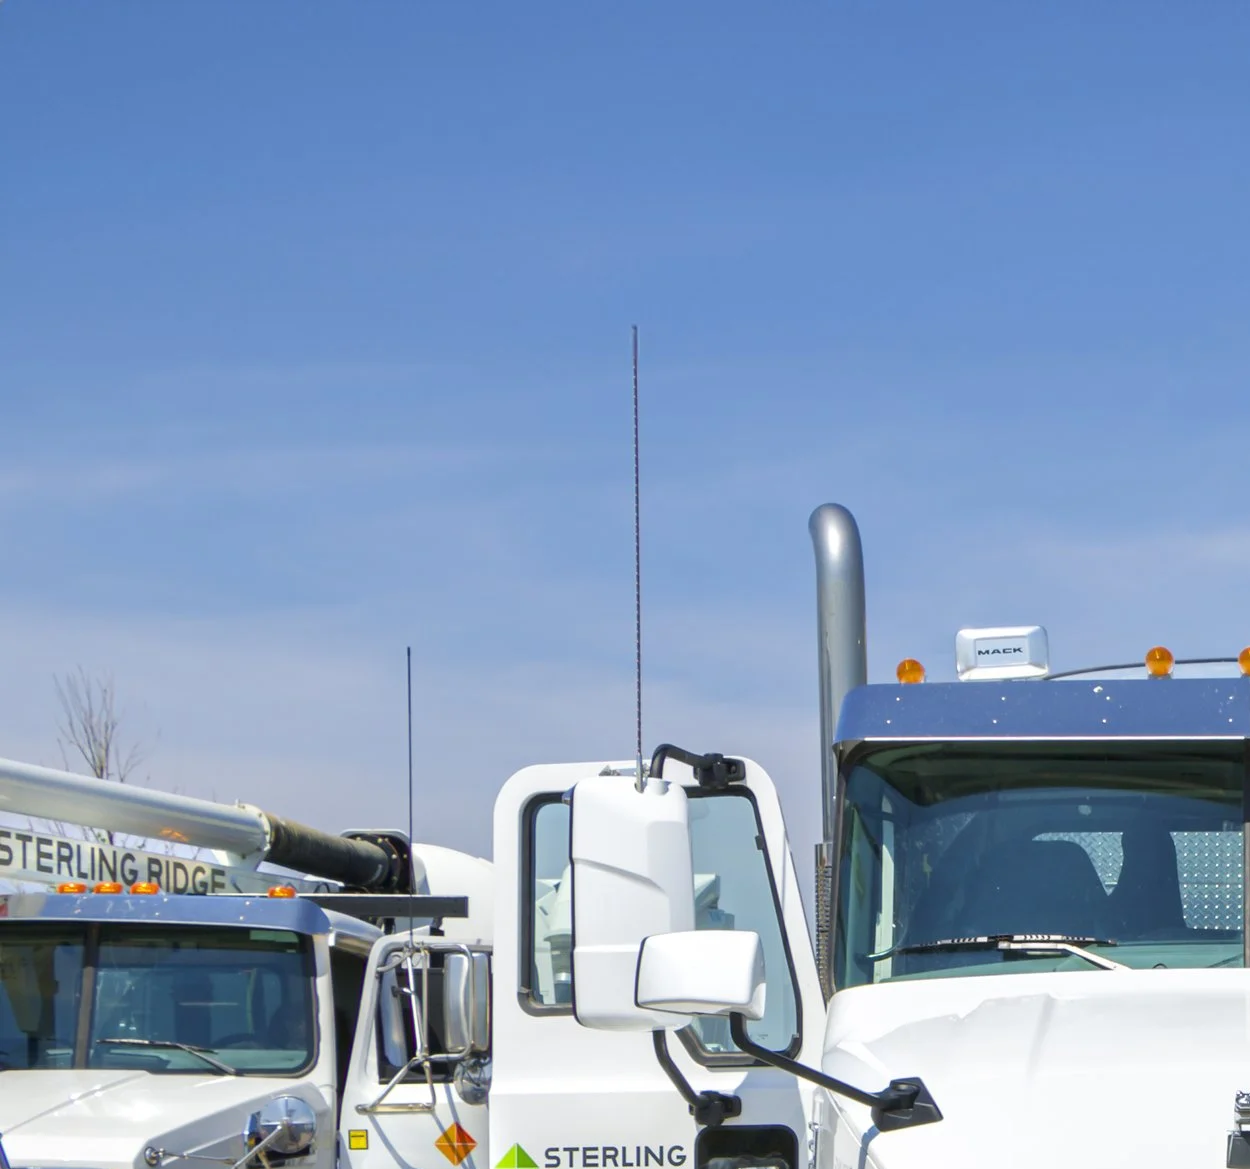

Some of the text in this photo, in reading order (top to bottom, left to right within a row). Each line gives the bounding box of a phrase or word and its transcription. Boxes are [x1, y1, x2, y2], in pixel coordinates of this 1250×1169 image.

[977, 647, 1023, 656] MACK
[0, 830, 226, 895] STERLING RIDGE
[544, 1145, 687, 1168] STERLING
